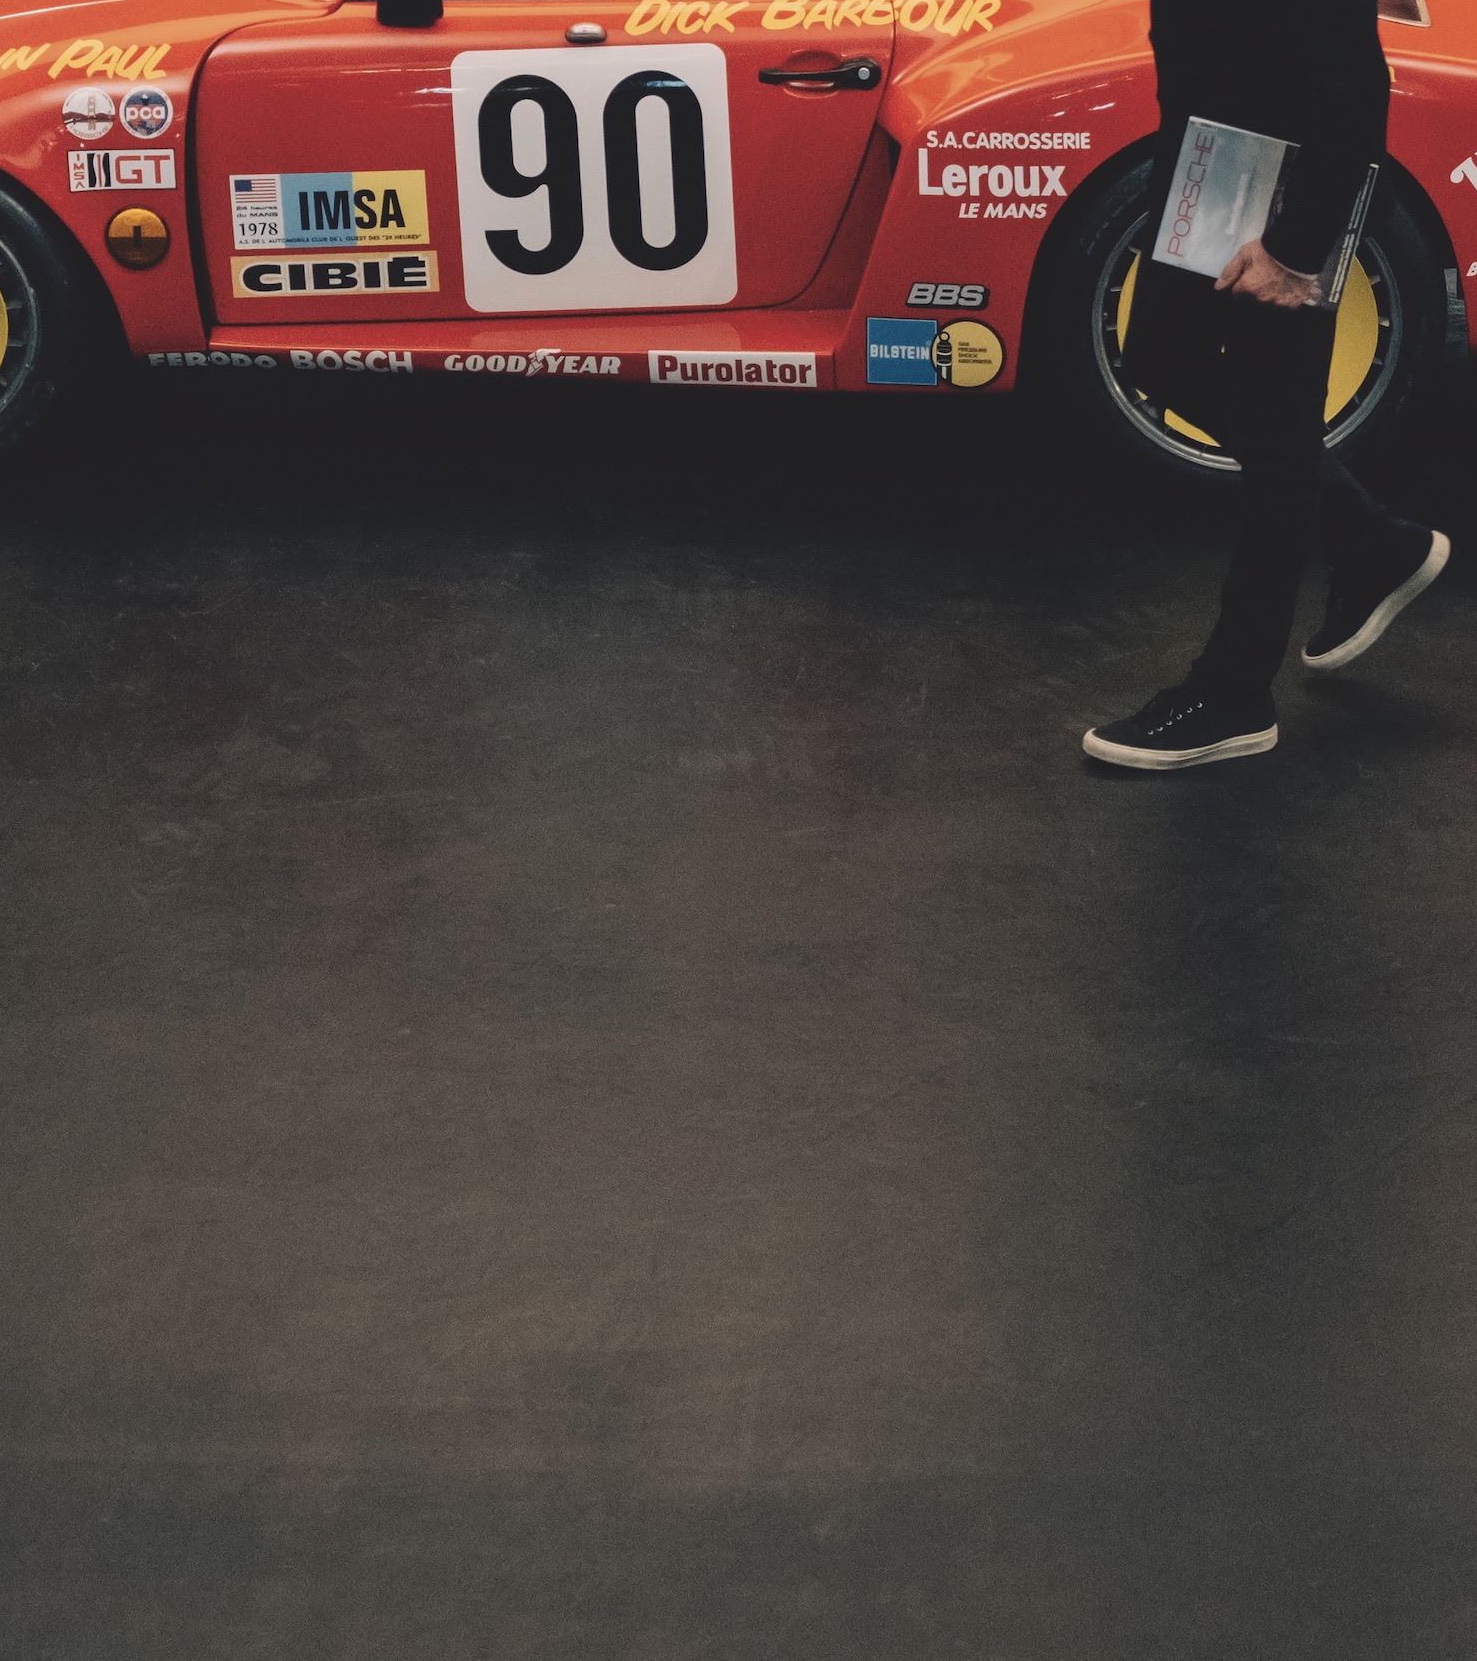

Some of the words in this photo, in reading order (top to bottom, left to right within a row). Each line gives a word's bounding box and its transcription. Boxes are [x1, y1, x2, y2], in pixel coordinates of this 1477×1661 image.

[48, 39, 172, 80] PAUL
[125, 106, 166, 122] pca
[115, 154, 171, 184] GT
[477, 69, 709, 275] 90
[917, 147, 1067, 199] Leroux
[1167, 132, 1214, 257] PORSCHE
[298, 189, 406, 230] IMSA
[958, 202, 981, 219] LE
[982, 202, 1047, 219] MANS
[238, 222, 278, 236] 1978
[906, 282, 986, 307] BBS
[147, 351, 278, 369] FERODO
[289, 349, 414, 373] BOSCH
[443, 348, 622, 377] GOODYEAR
[870, 344, 930, 360] BILSTEIN
[656, 355, 812, 385] Purolator
